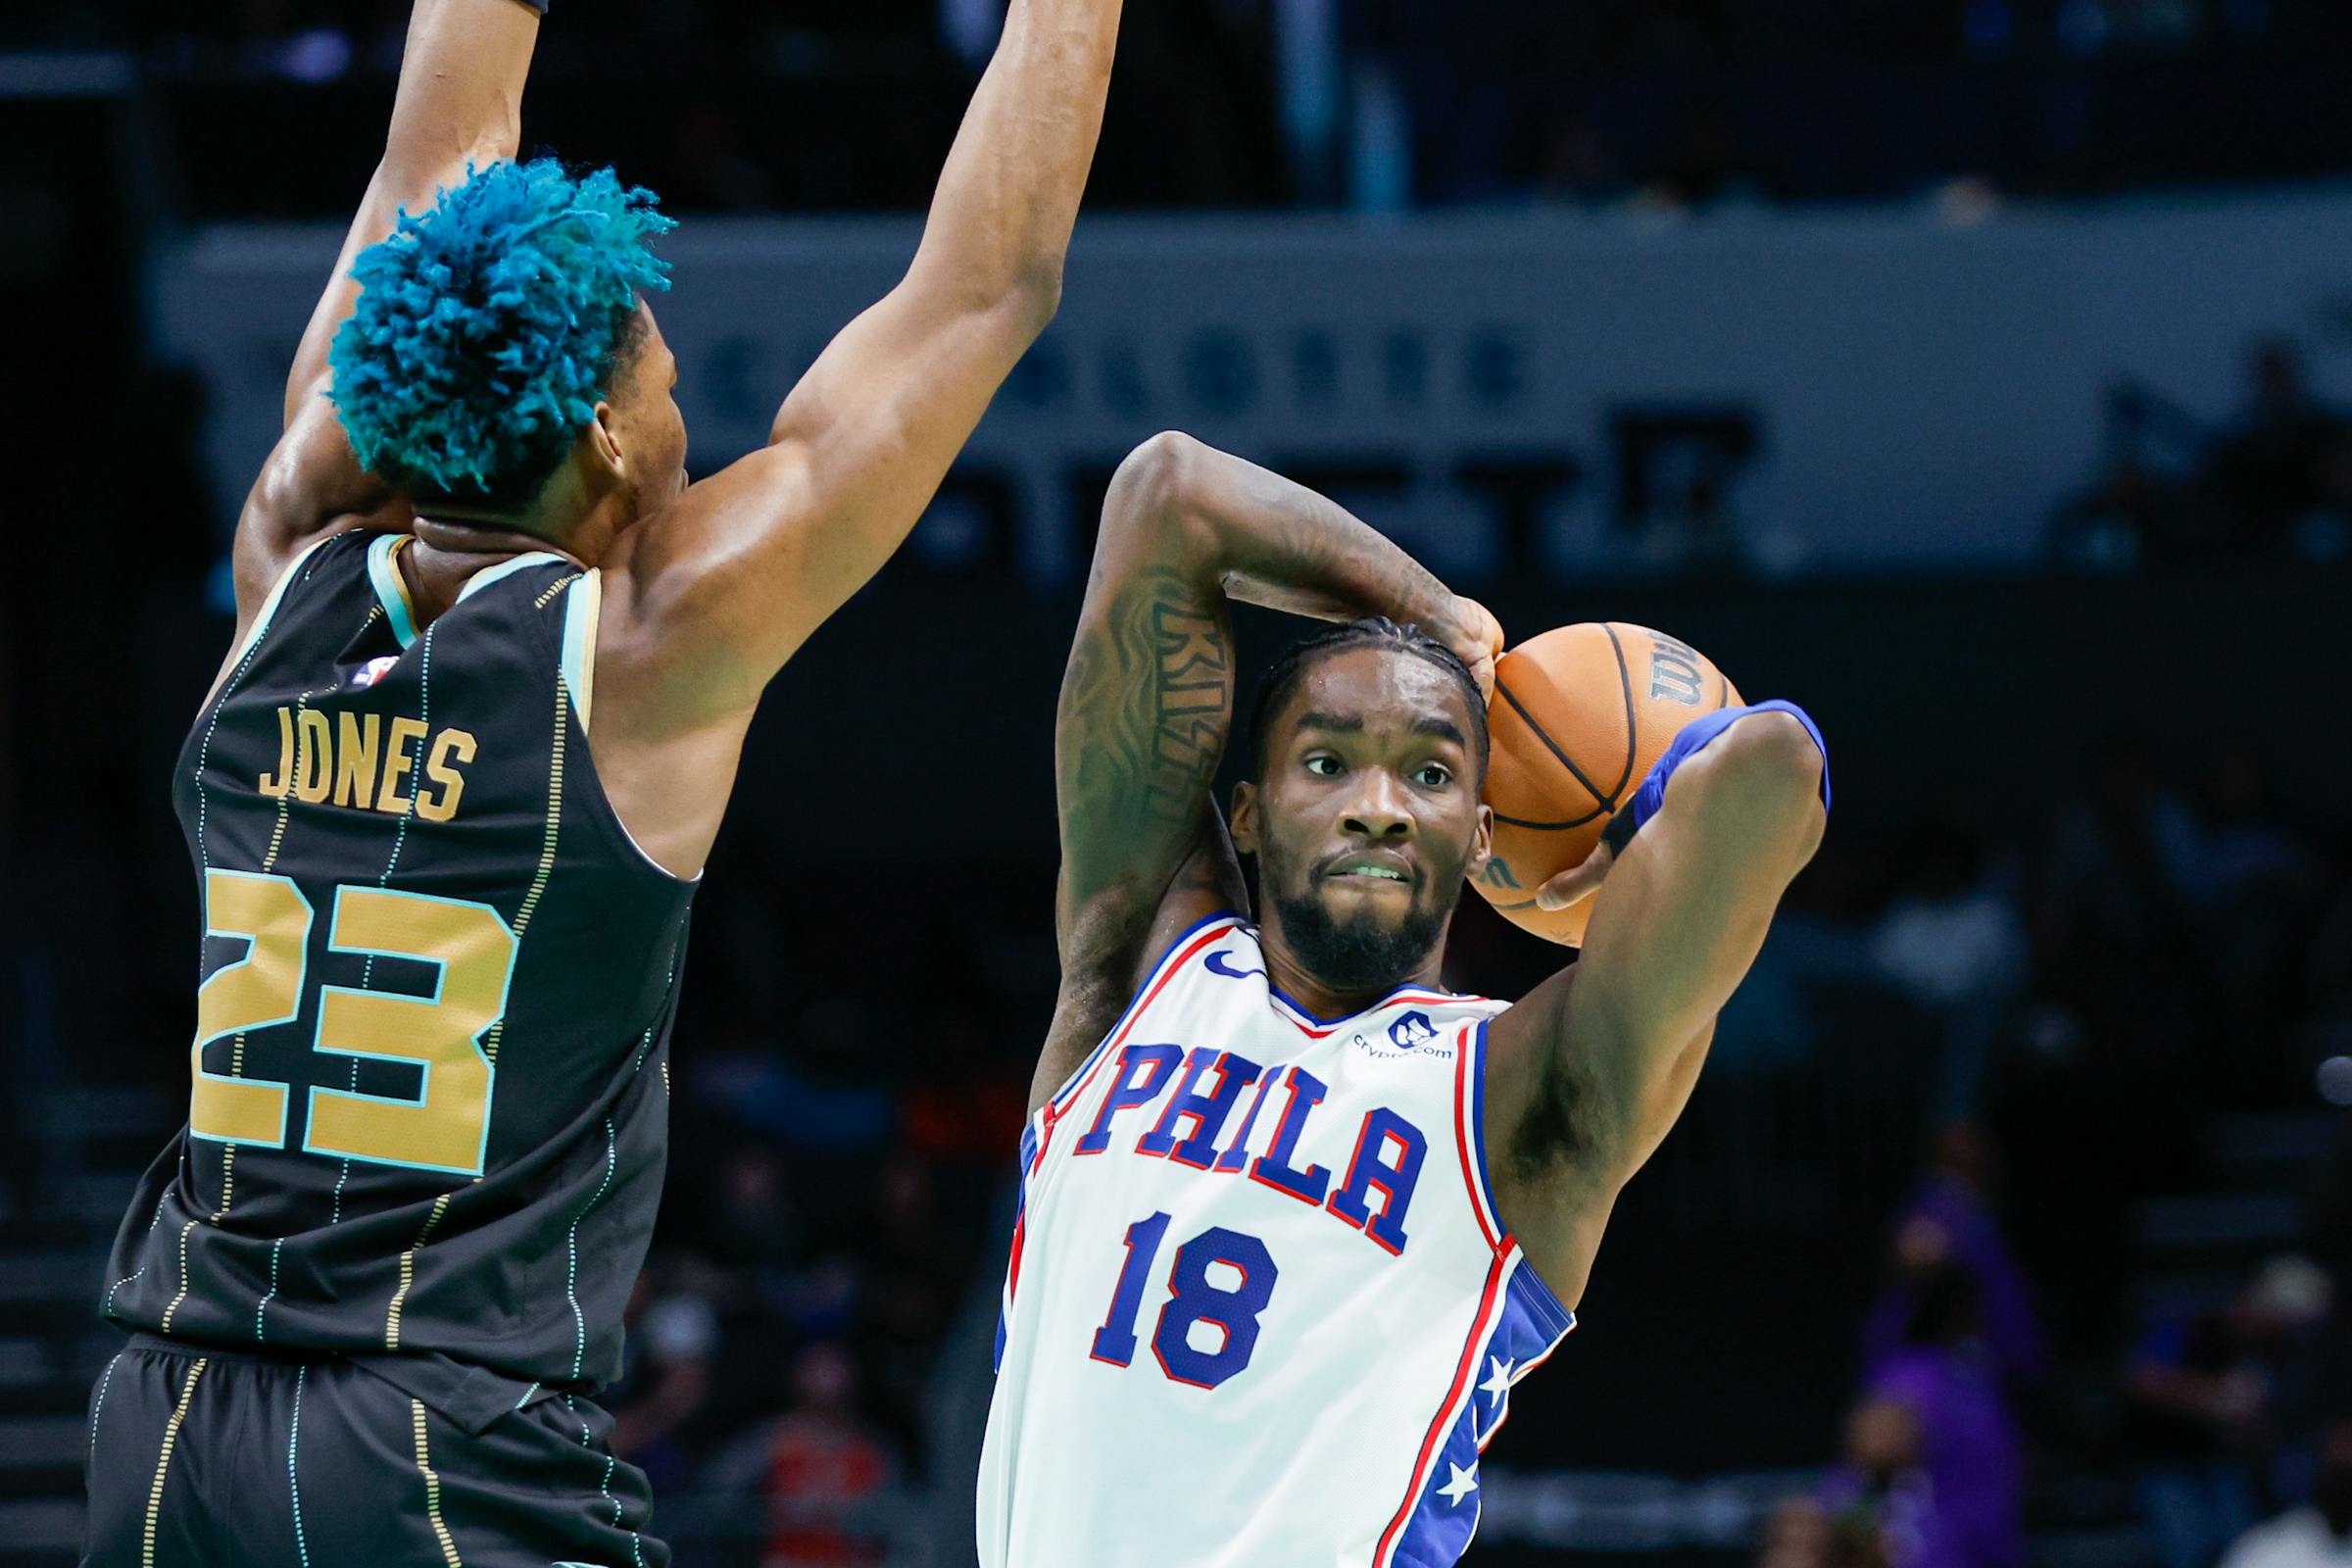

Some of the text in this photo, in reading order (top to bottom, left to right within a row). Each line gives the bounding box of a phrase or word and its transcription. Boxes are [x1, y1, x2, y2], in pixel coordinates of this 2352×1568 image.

[258, 707, 477, 822] JONES
[190, 867, 520, 1177] 23
[1073, 1044, 1428, 1257] PHILA
[1089, 1210, 1279, 1391] 18
